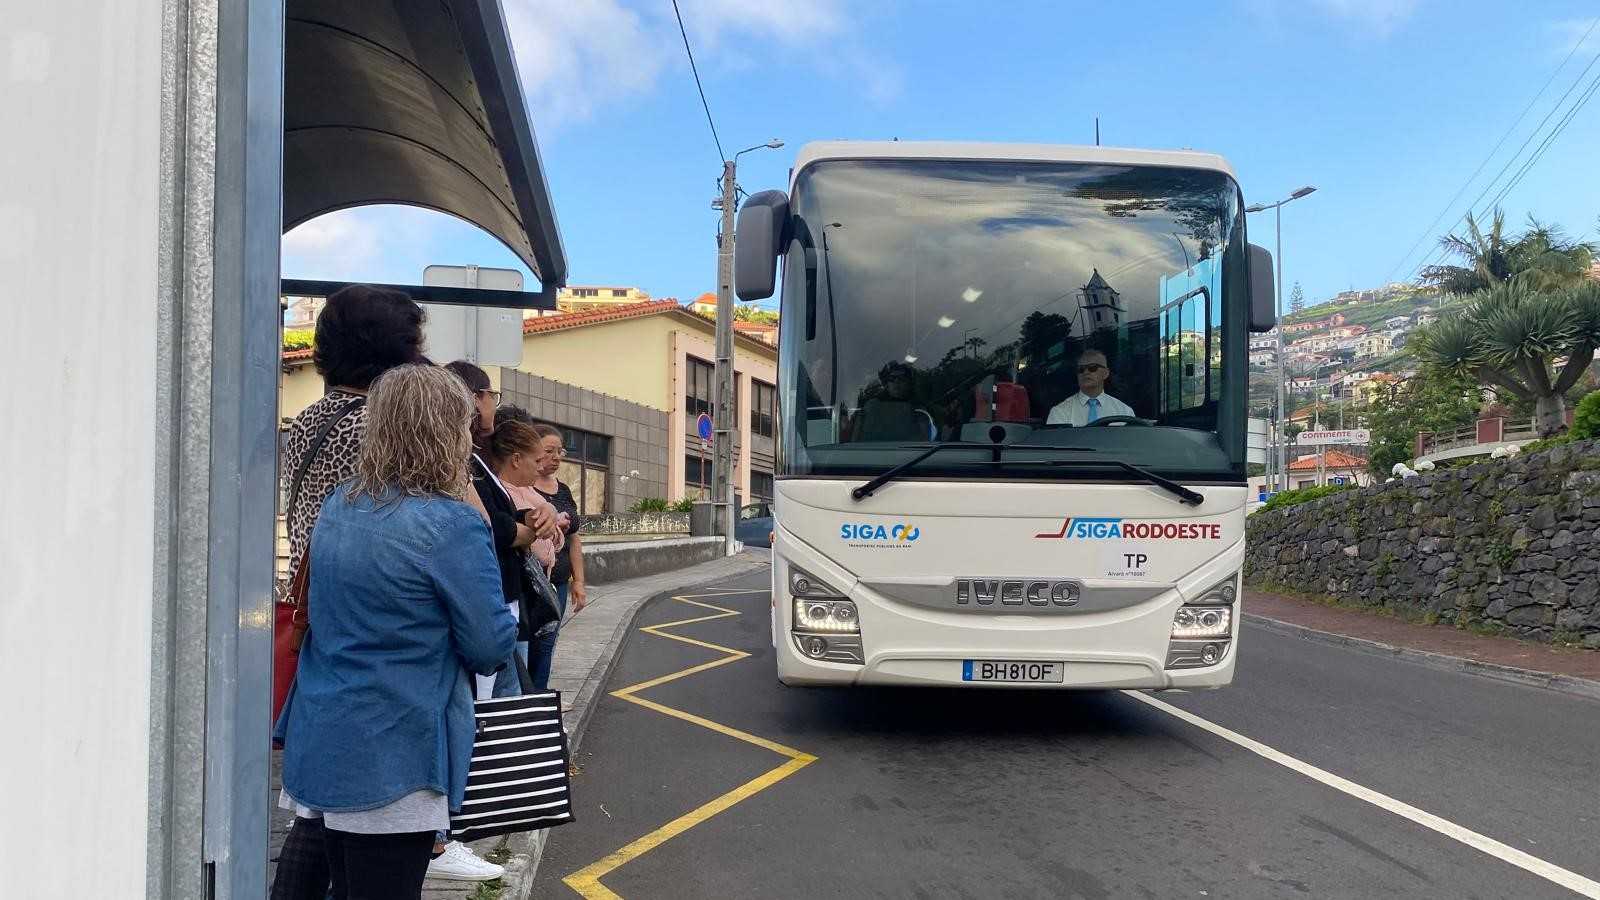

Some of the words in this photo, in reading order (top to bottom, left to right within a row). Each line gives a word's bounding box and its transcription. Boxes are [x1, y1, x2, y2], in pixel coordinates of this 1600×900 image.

[1302, 431, 1351, 439] CONTINENTE
[841, 524, 887, 539] SIGA
[1123, 554, 1147, 568] TP
[957, 580, 1080, 606] IVECO
